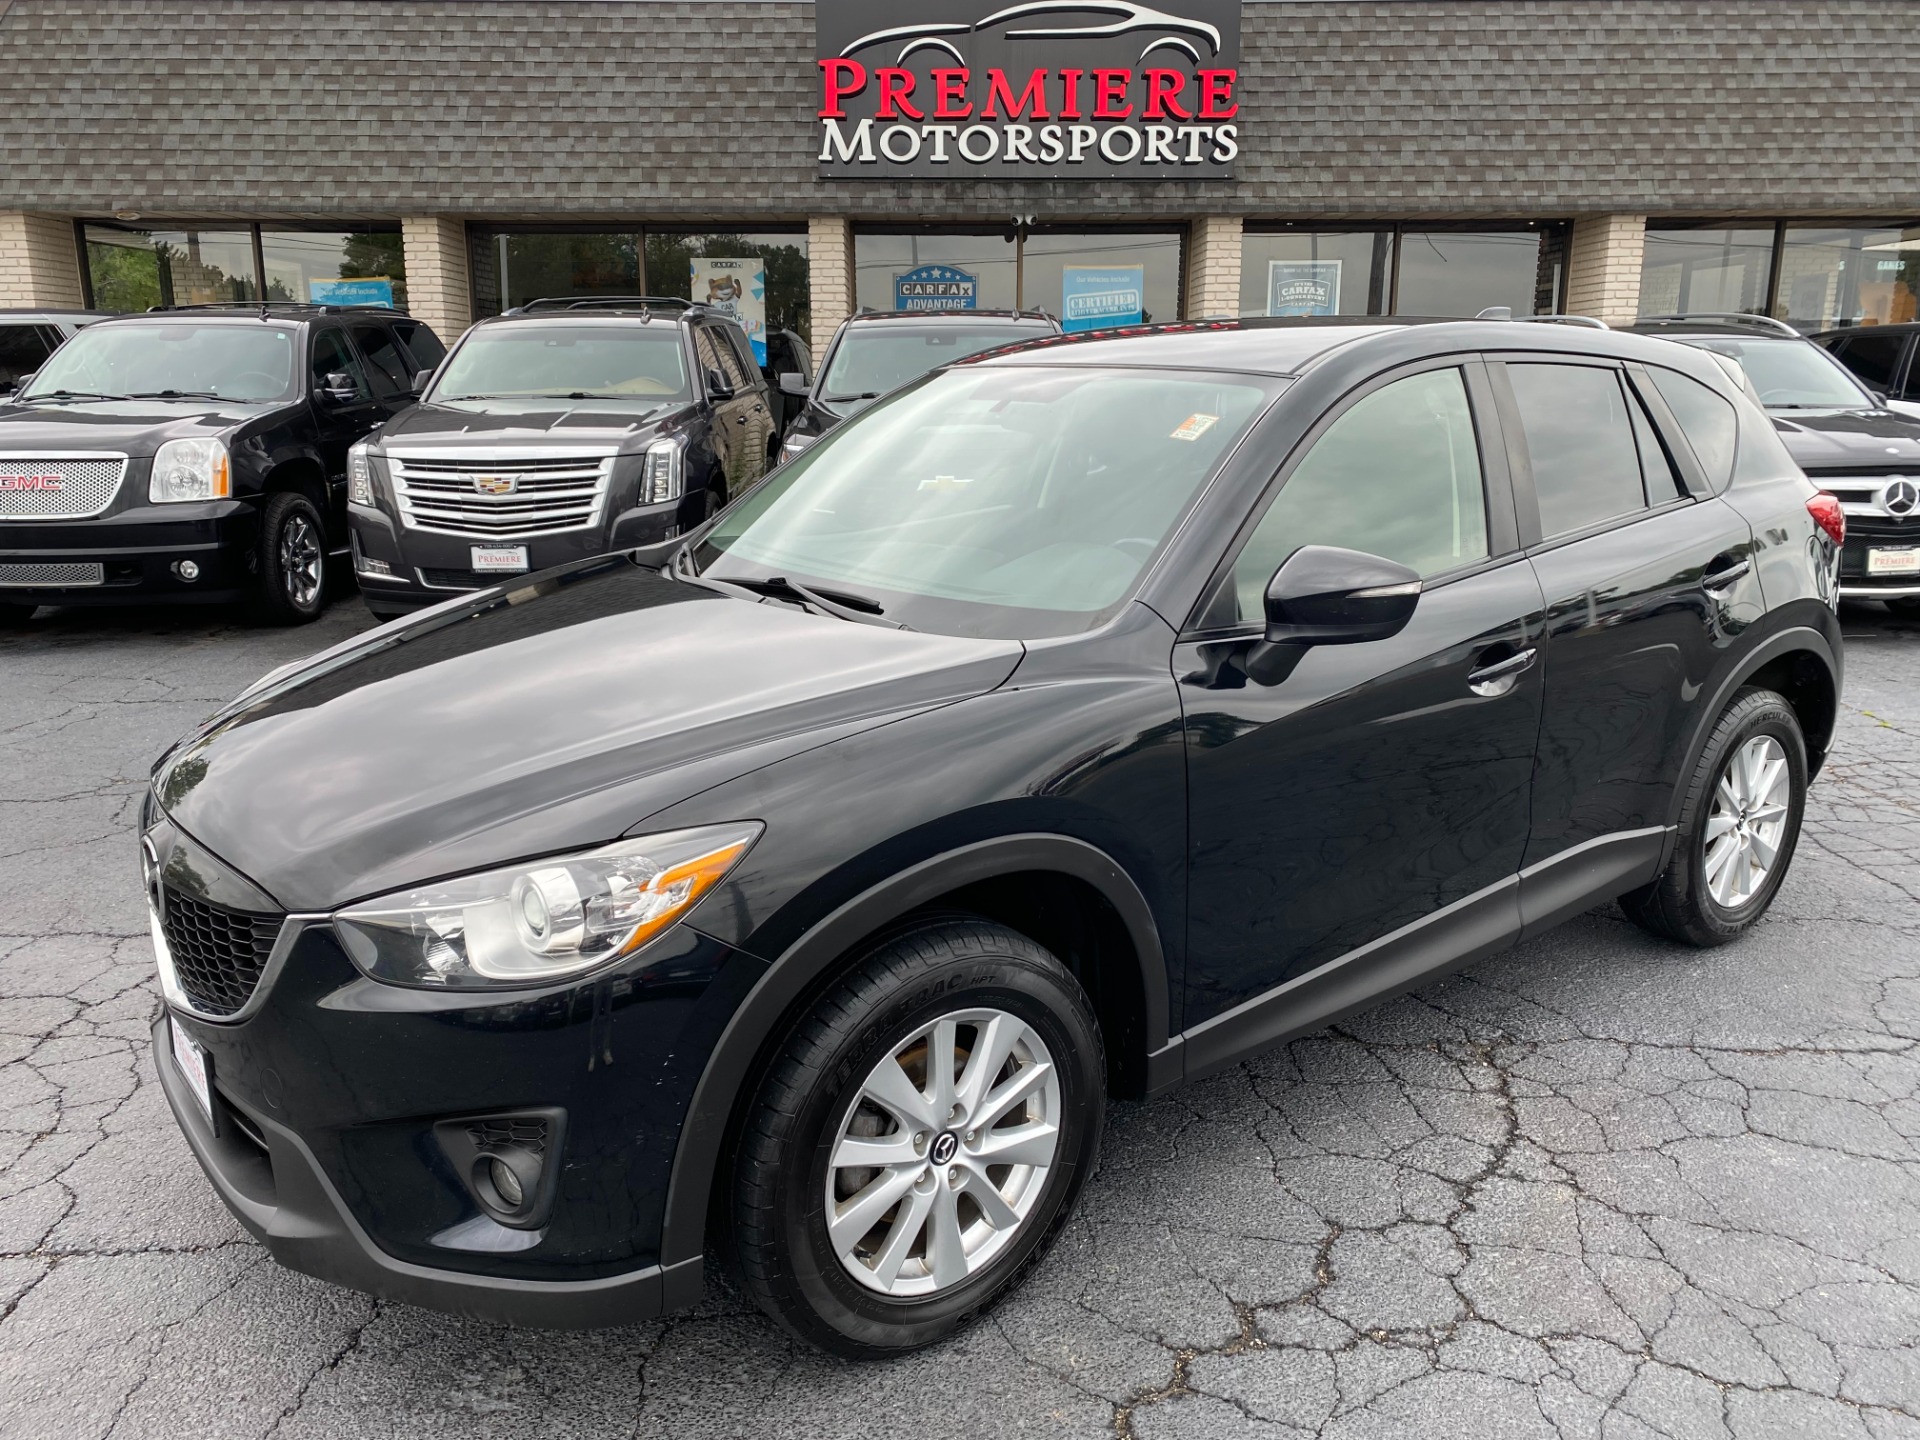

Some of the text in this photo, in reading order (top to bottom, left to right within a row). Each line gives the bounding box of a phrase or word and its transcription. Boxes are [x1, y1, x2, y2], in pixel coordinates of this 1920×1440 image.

[817, 58, 1240, 121] PREMIERE
[818, 118, 1239, 163] MOTORSPORTS
[901, 283, 971, 296] CARFAX
[1281, 286, 1326, 296] CARFAX
[1070, 293, 1135, 309] CERTIFIED
[0, 476, 61, 490] GMC
[478, 555, 522, 563] PREMIERE
[900, 974, 963, 1014] TRAC
[969, 974, 998, 985] HPT
